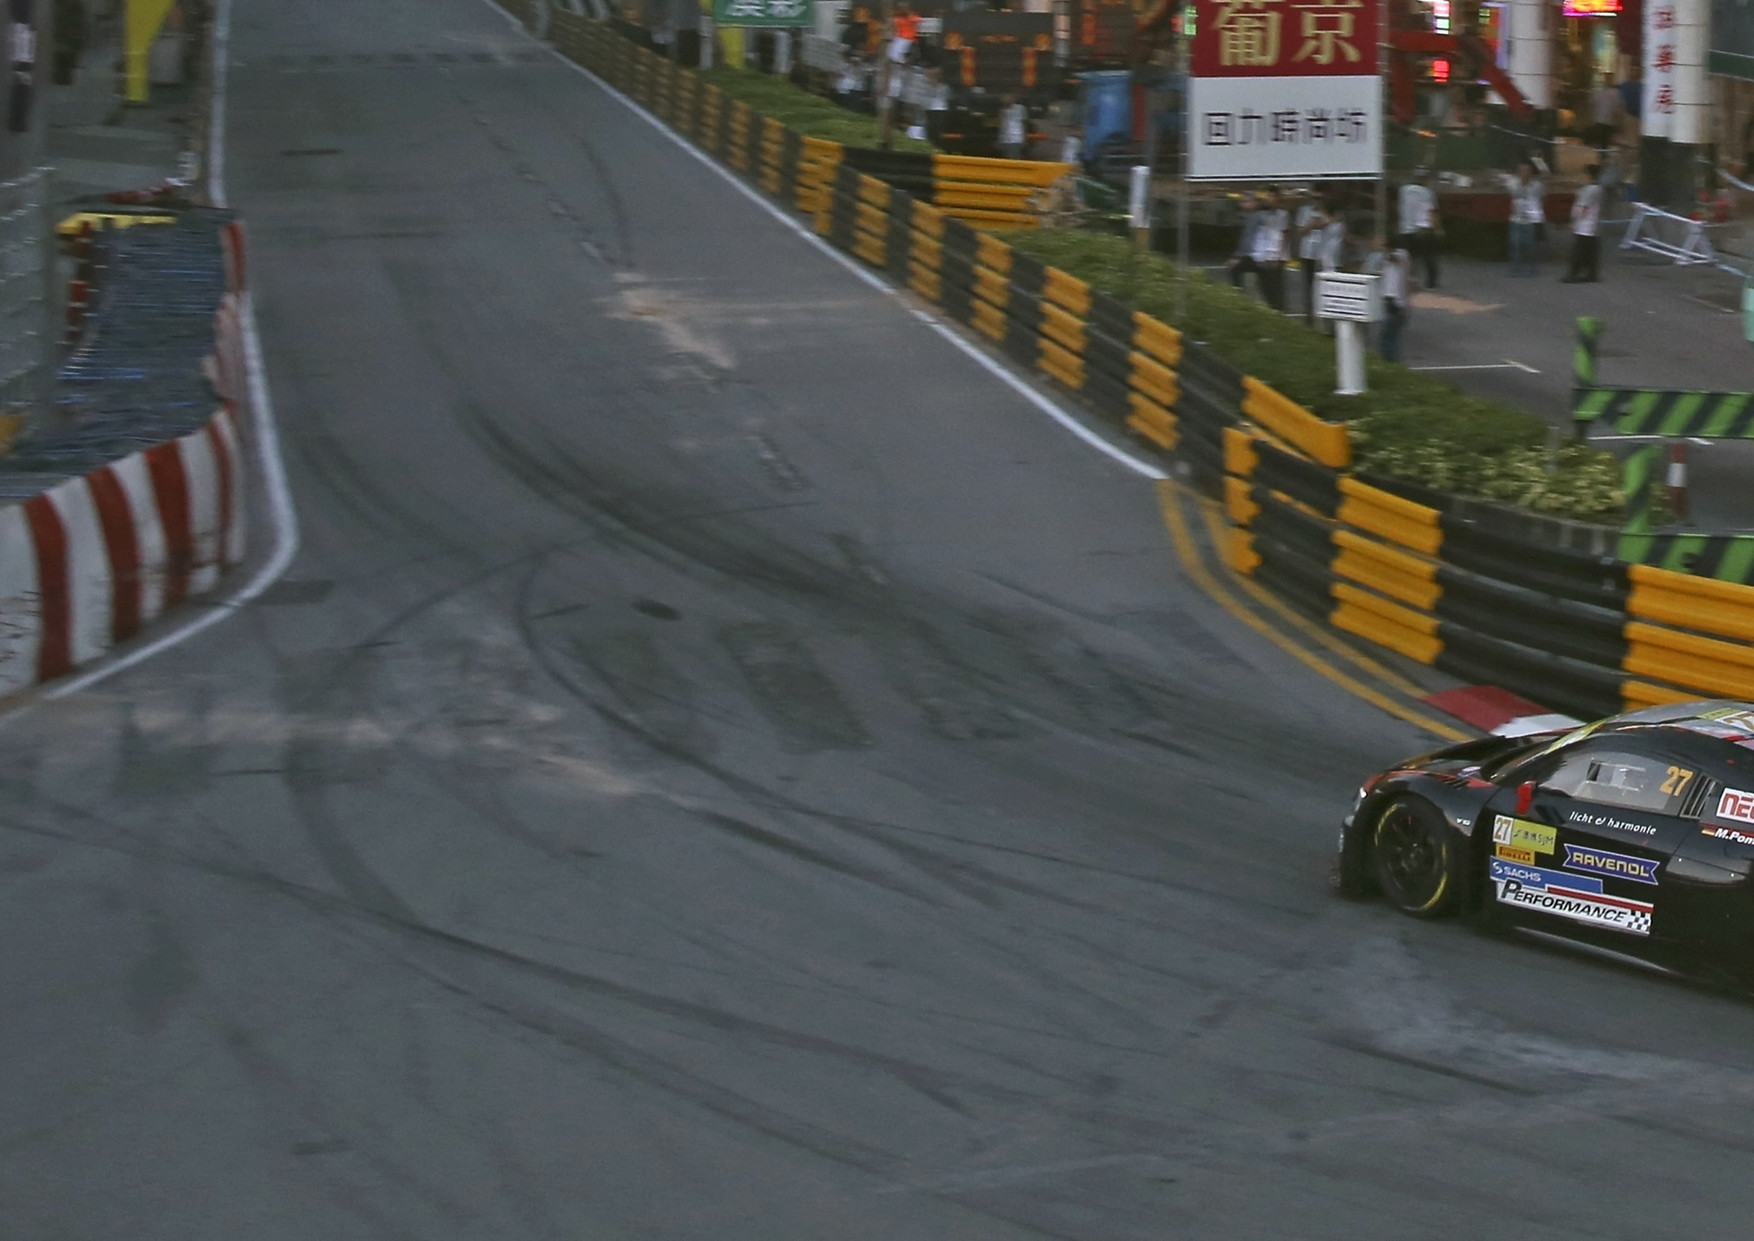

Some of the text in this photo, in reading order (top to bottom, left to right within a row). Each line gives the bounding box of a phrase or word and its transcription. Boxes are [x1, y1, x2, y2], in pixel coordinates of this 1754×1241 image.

[1659, 765, 1694, 797] 27
[1569, 810, 1593, 825] licht
[1608, 816, 1657, 836] harmonie
[1503, 865, 1542, 882] SACHS
[1571, 851, 1651, 879] RAVENOL
[1500, 879, 1628, 924] PERFORMANCE
